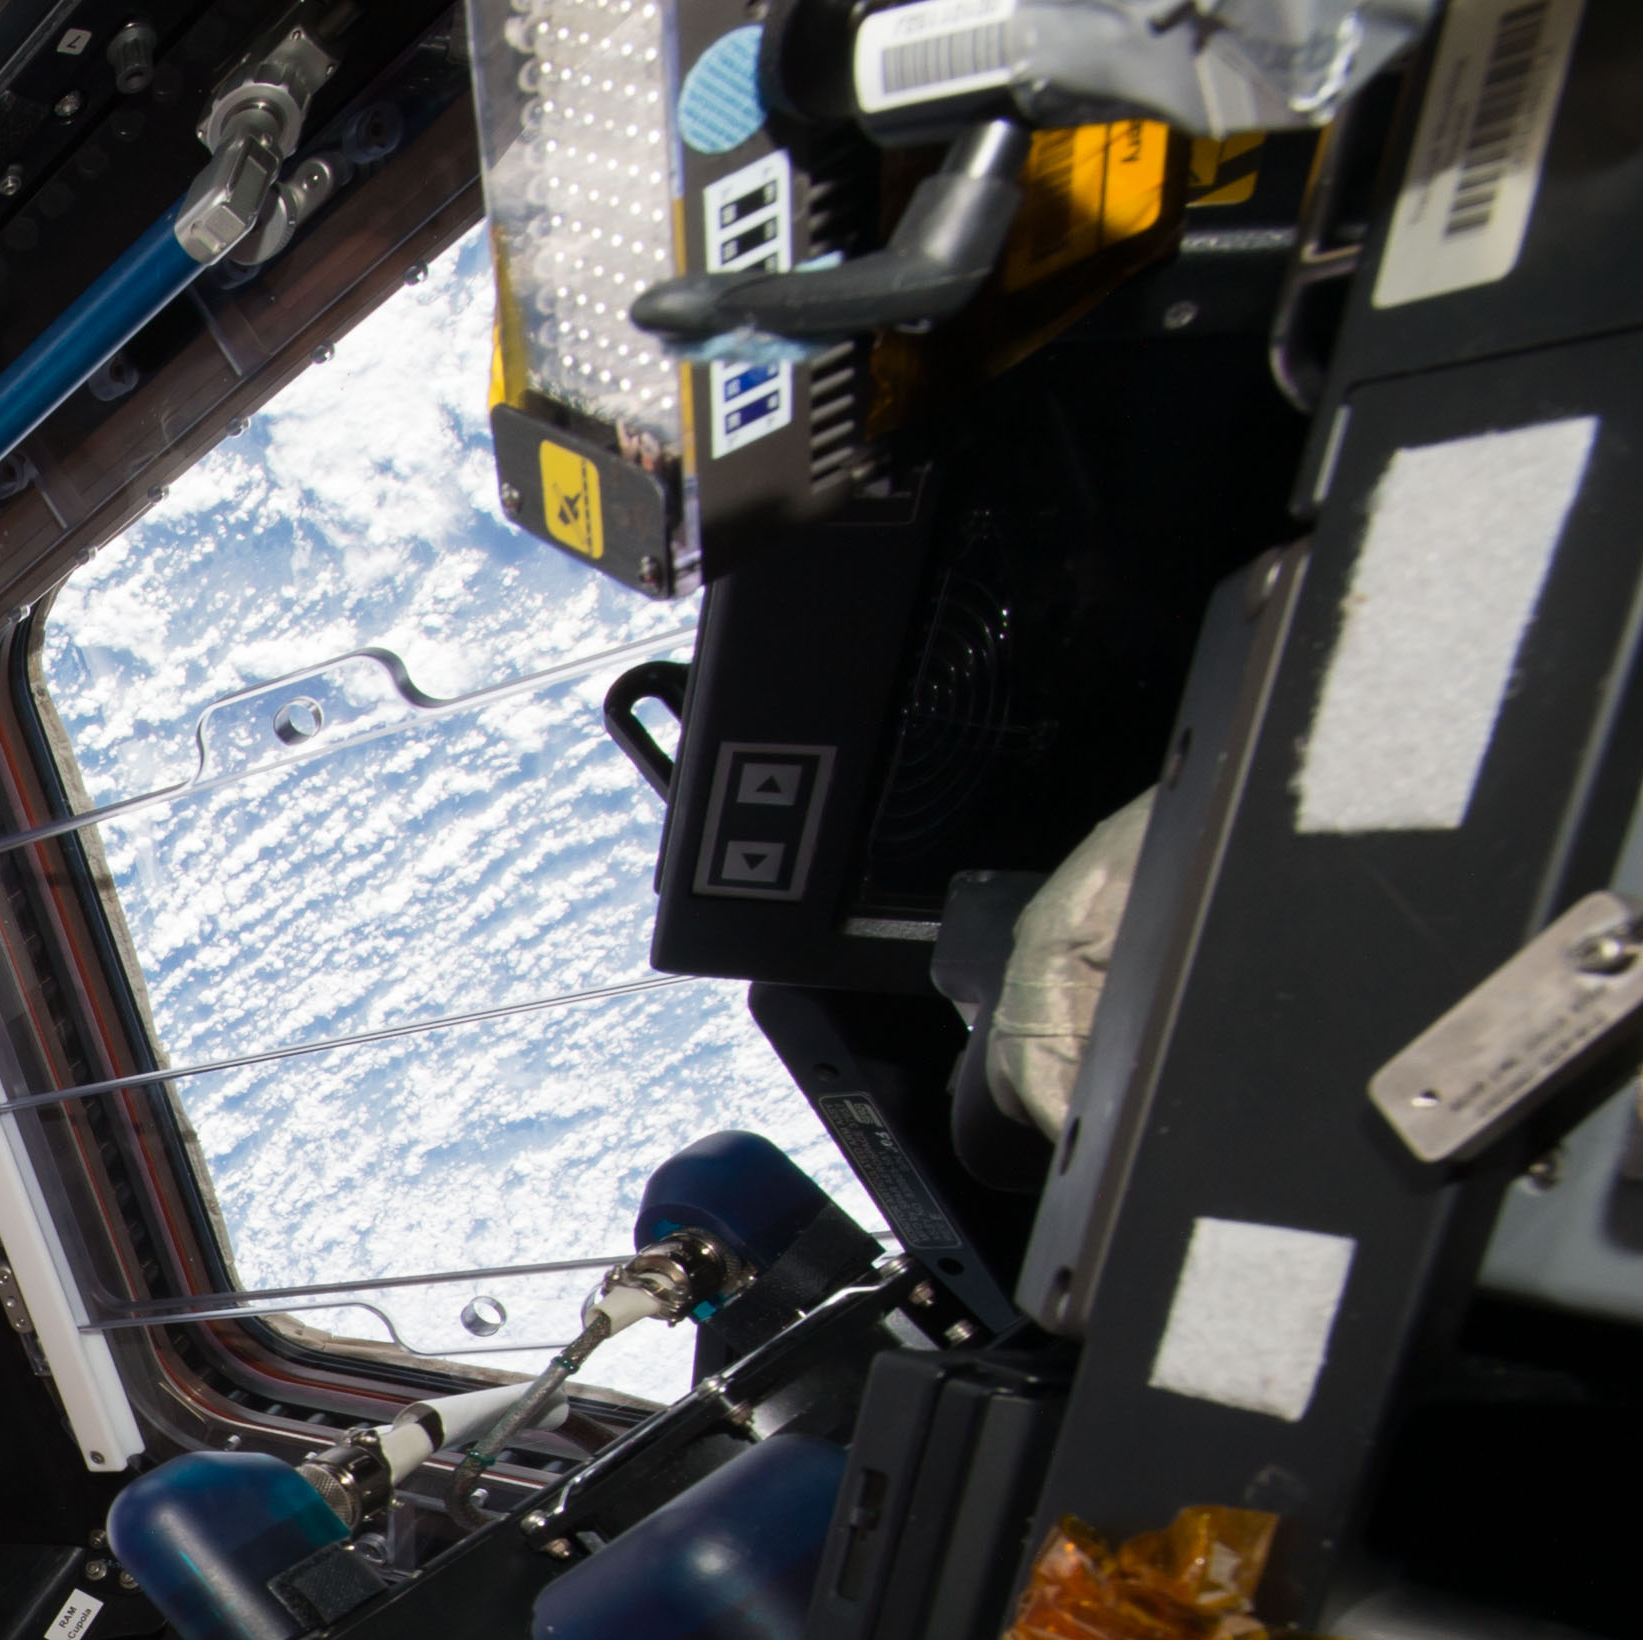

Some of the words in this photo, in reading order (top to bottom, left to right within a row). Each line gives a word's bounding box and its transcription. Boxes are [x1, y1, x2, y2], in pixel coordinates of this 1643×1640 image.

[65, 31, 82, 49] 7
[57, 1604, 79, 1630] RAM
[66, 1605, 94, 1640] Cupola
